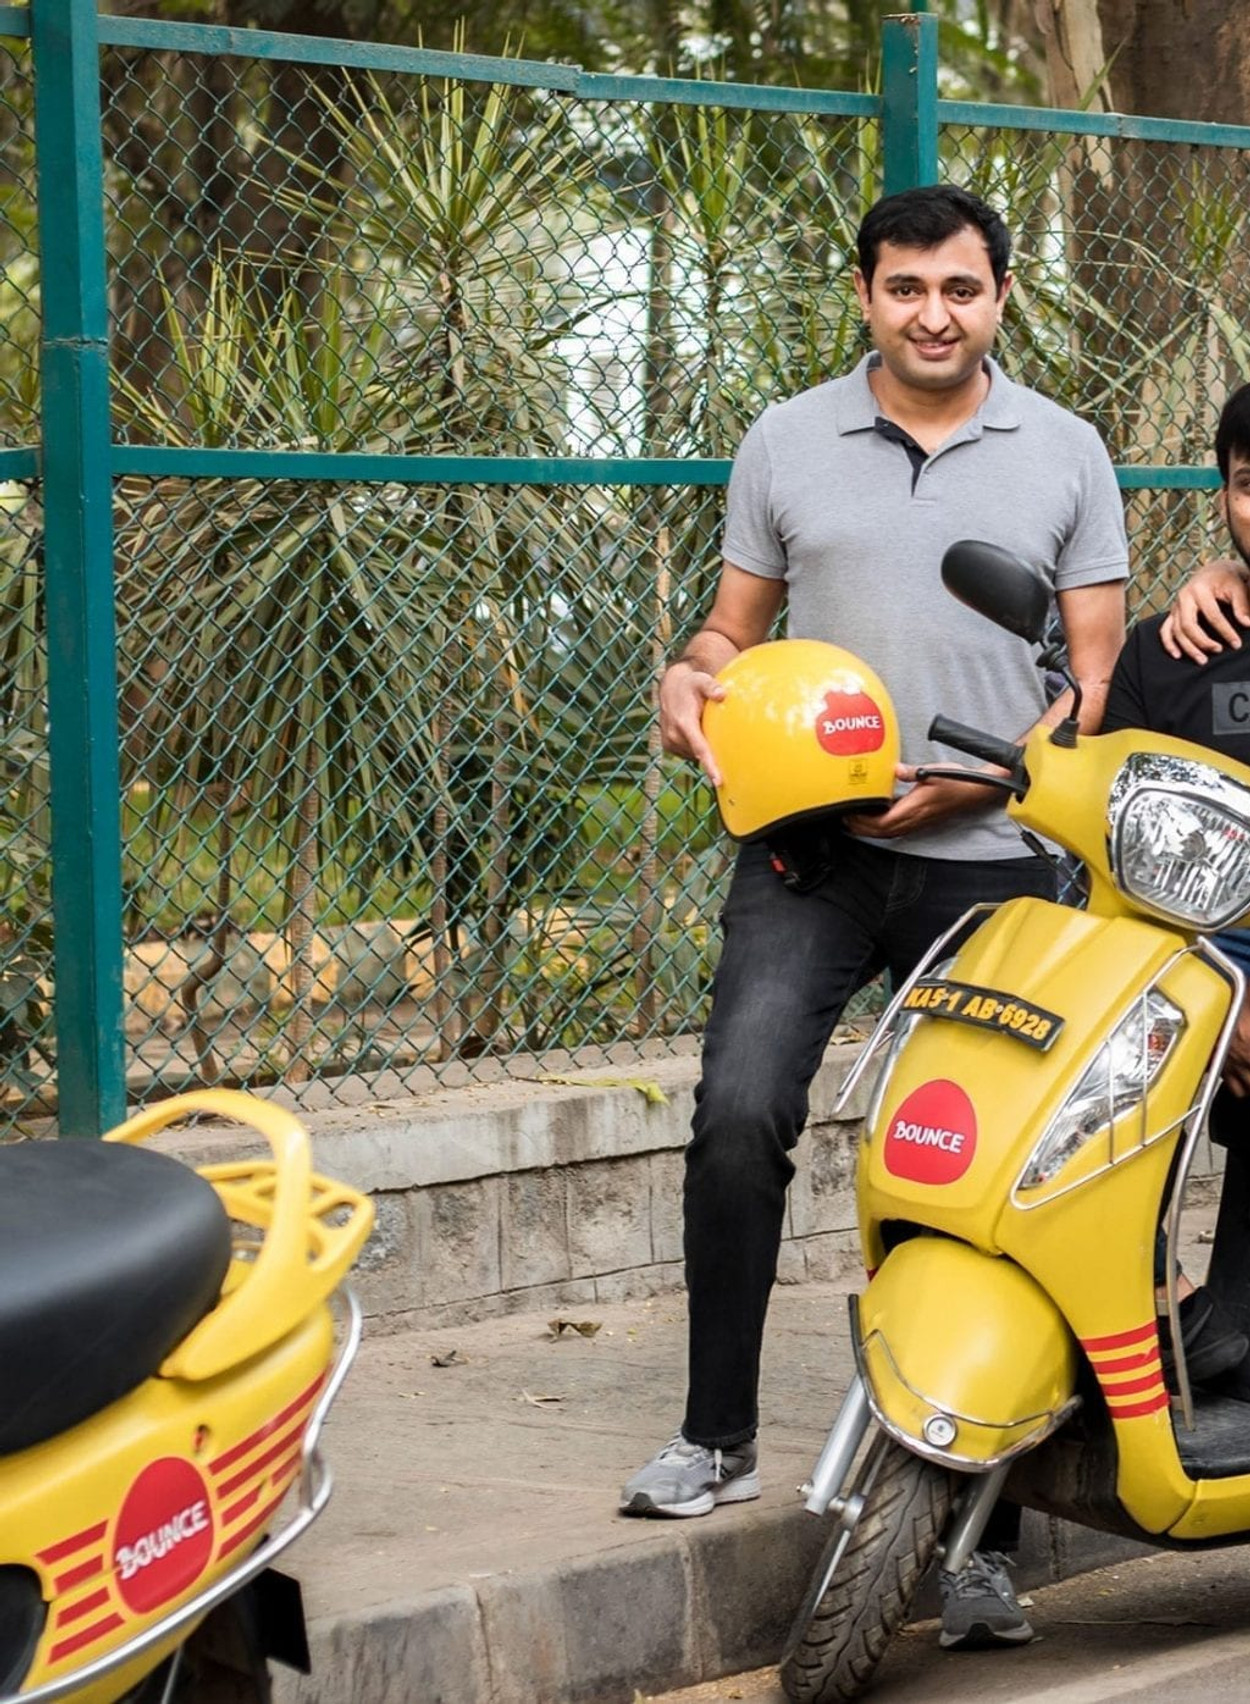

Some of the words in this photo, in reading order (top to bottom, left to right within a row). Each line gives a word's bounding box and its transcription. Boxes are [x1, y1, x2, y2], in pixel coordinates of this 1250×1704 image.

[822, 715, 880, 735] BOUNCE
[893, 1120, 965, 1153] BOUNCE
[116, 1501, 210, 1580] BOUNCE
